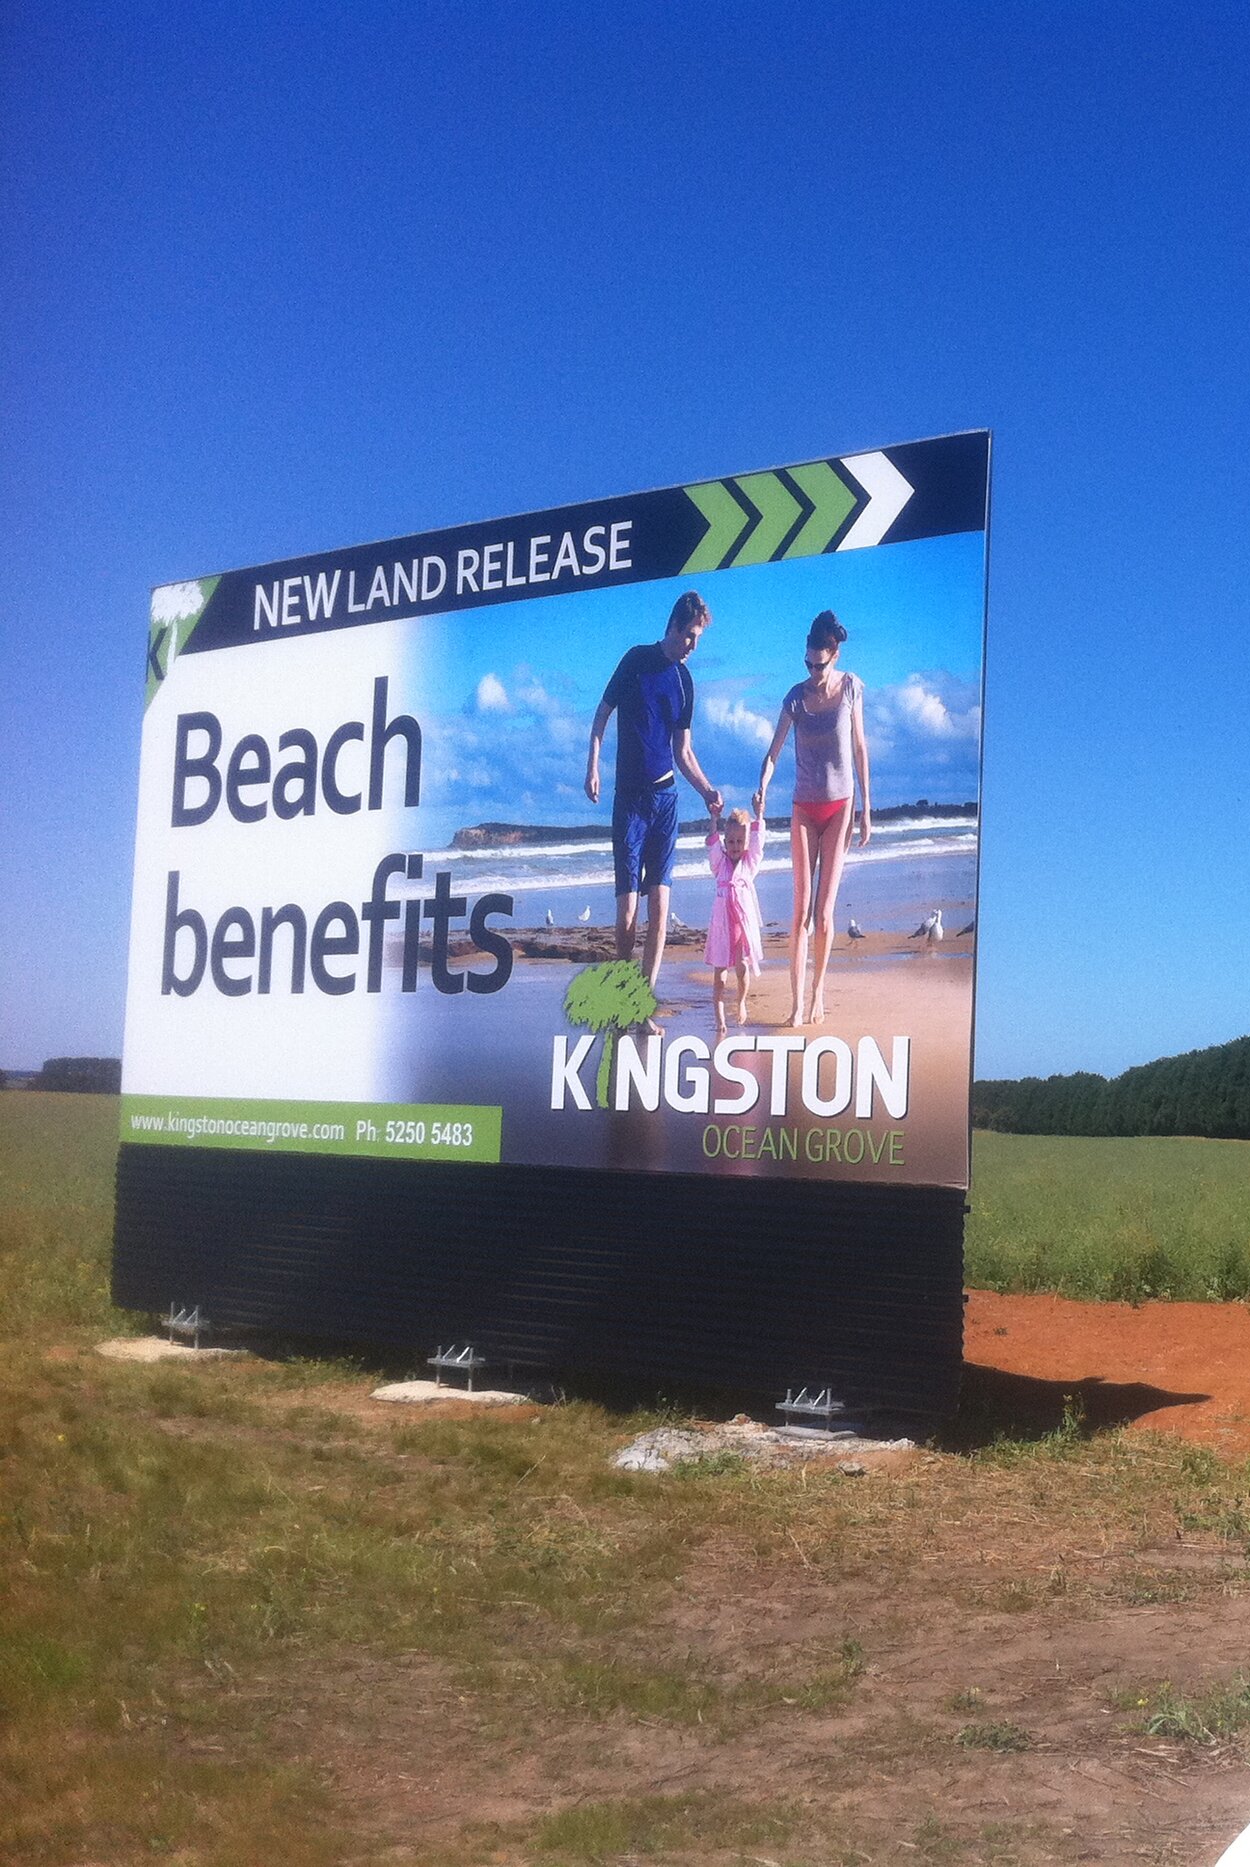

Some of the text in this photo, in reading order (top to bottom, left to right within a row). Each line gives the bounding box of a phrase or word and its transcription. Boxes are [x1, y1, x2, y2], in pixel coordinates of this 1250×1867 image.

[253, 520, 633, 630] NEW LAND RELEASE
[171, 676, 422, 828] Beach
[161, 853, 514, 998] benefits
[551, 1035, 910, 1119] KINGSTON
[131, 1111, 345, 1143] www.kingstonoceangrove.com
[385, 1120, 425, 1145] 5250
[431, 1122, 473, 1146] 5483
[703, 1124, 905, 1165] OCEAN GROVE
